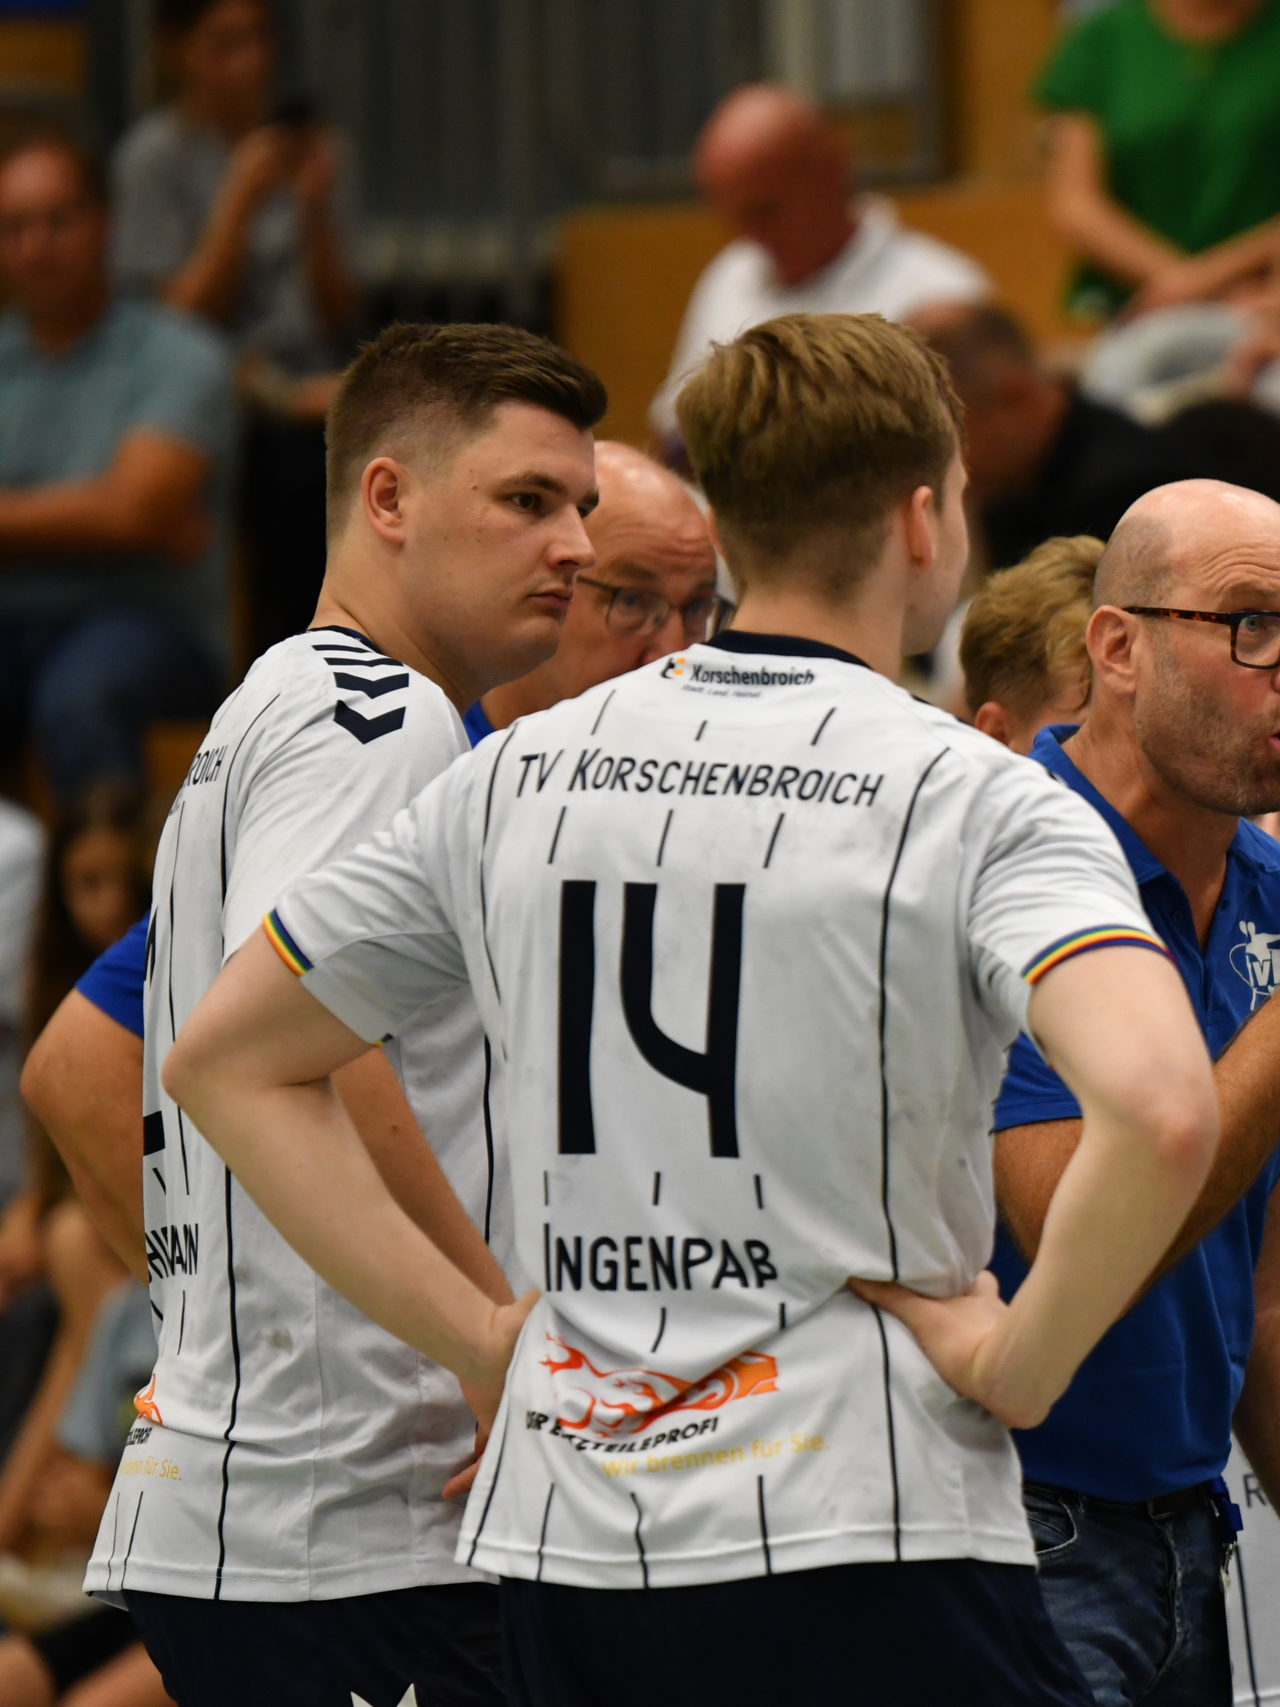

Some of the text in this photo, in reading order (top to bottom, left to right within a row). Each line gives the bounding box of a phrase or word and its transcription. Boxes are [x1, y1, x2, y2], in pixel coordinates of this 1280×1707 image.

[690, 663, 815, 685] Korschenbroich
[517, 748, 884, 807] TV KORSCHENBROICH
[557, 880, 747, 1159] 14
[602, 1458, 639, 1479] Wir
[646, 1445, 746, 1474] brennen
[751, 1440, 784, 1460] für
